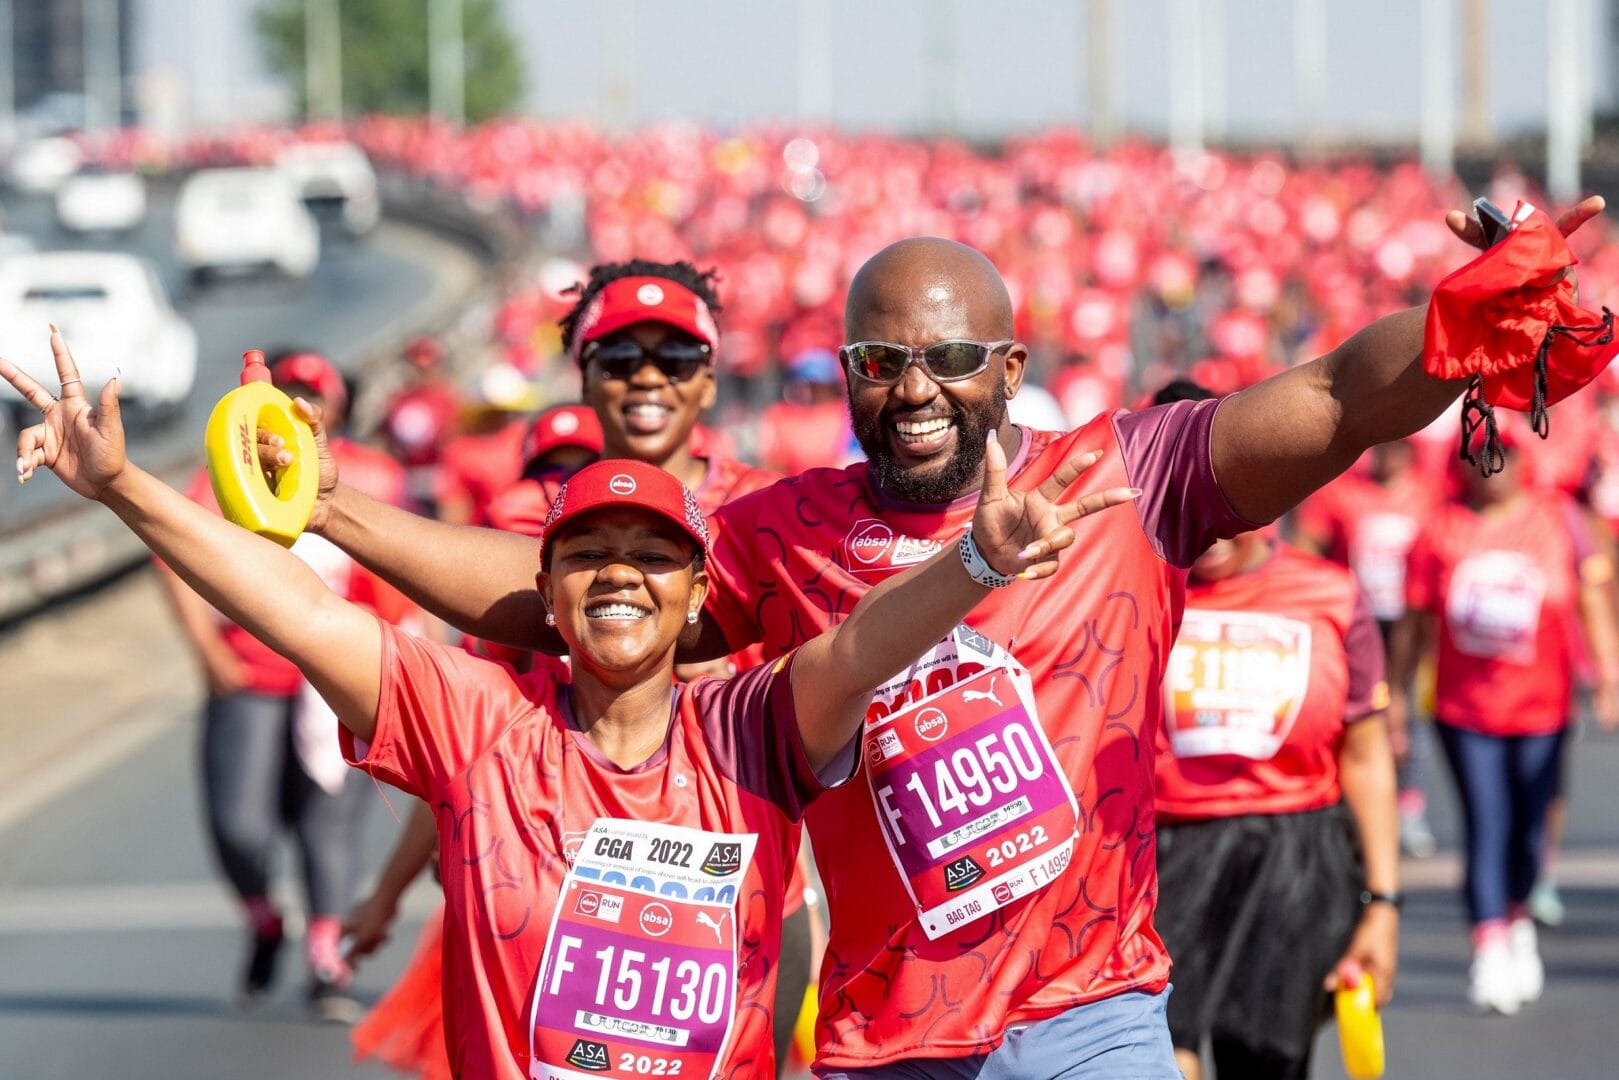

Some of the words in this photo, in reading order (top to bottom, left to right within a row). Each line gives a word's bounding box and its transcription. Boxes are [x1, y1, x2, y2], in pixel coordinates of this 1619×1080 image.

[239, 423, 252, 465] DHL
[856, 535, 887, 547] absa
[918, 715, 944, 733] absa
[880, 733, 896, 746] RUN
[878, 783, 906, 845] F
[906, 722, 1044, 828] 14950
[595, 837, 634, 861] CGA
[647, 837, 693, 868] 2022
[708, 846, 740, 863] ASA
[986, 825, 1049, 868] 2022
[947, 859, 977, 882] ASA
[1029, 868, 1039, 886] F
[601, 898, 620, 910] RUN
[946, 908, 965, 925] BAG
[963, 900, 982, 917] TAG
[643, 911, 669, 926] absa
[550, 934, 582, 995] F
[595, 945, 728, 1024] 15130
[573, 1041, 606, 1061] ASA
[618, 1053, 683, 1076] 2022
